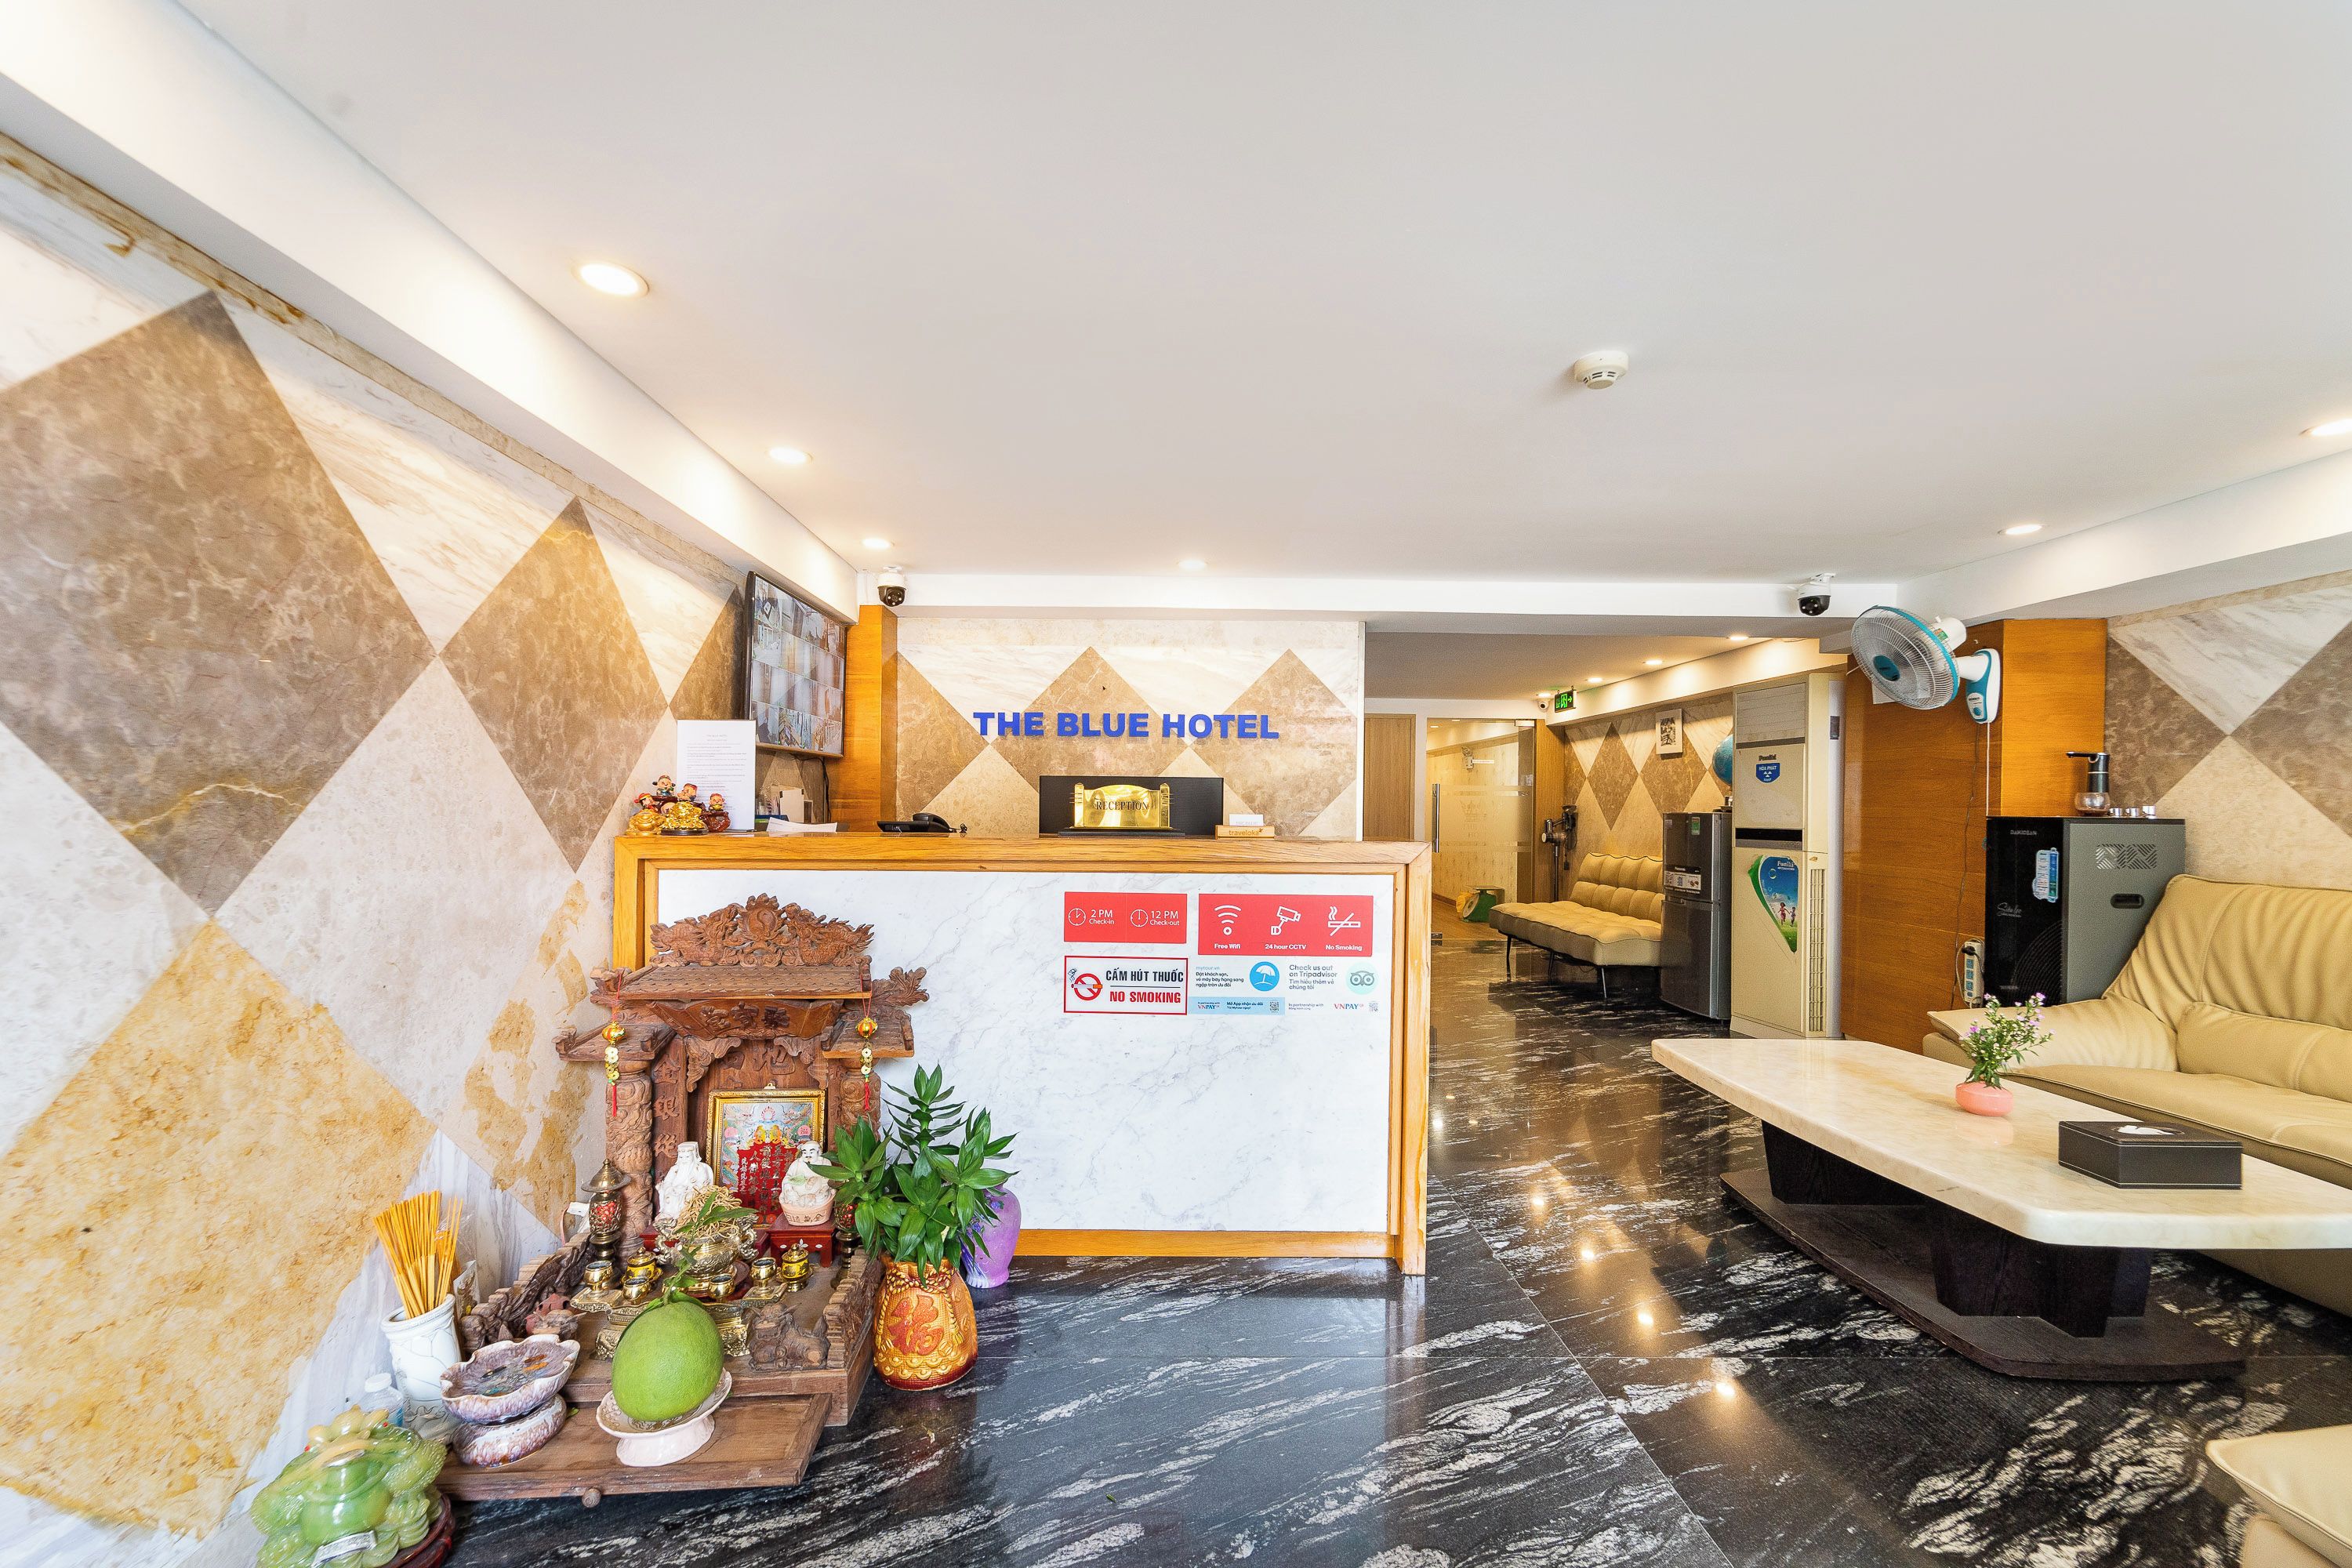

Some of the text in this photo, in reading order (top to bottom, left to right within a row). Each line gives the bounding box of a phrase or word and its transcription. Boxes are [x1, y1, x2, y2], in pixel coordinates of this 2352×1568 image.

[973, 712, 1279, 739] THE BLUE HOTEL
[1096, 800, 1149, 811] RECEPTION
[1091, 909, 1113, 918] 2 PM
[1164, 911, 1178, 920] PM
[1105, 967, 1184, 982] CẤM HÚT THUỐC
[1109, 991, 1181, 1004] NO SMOKING
